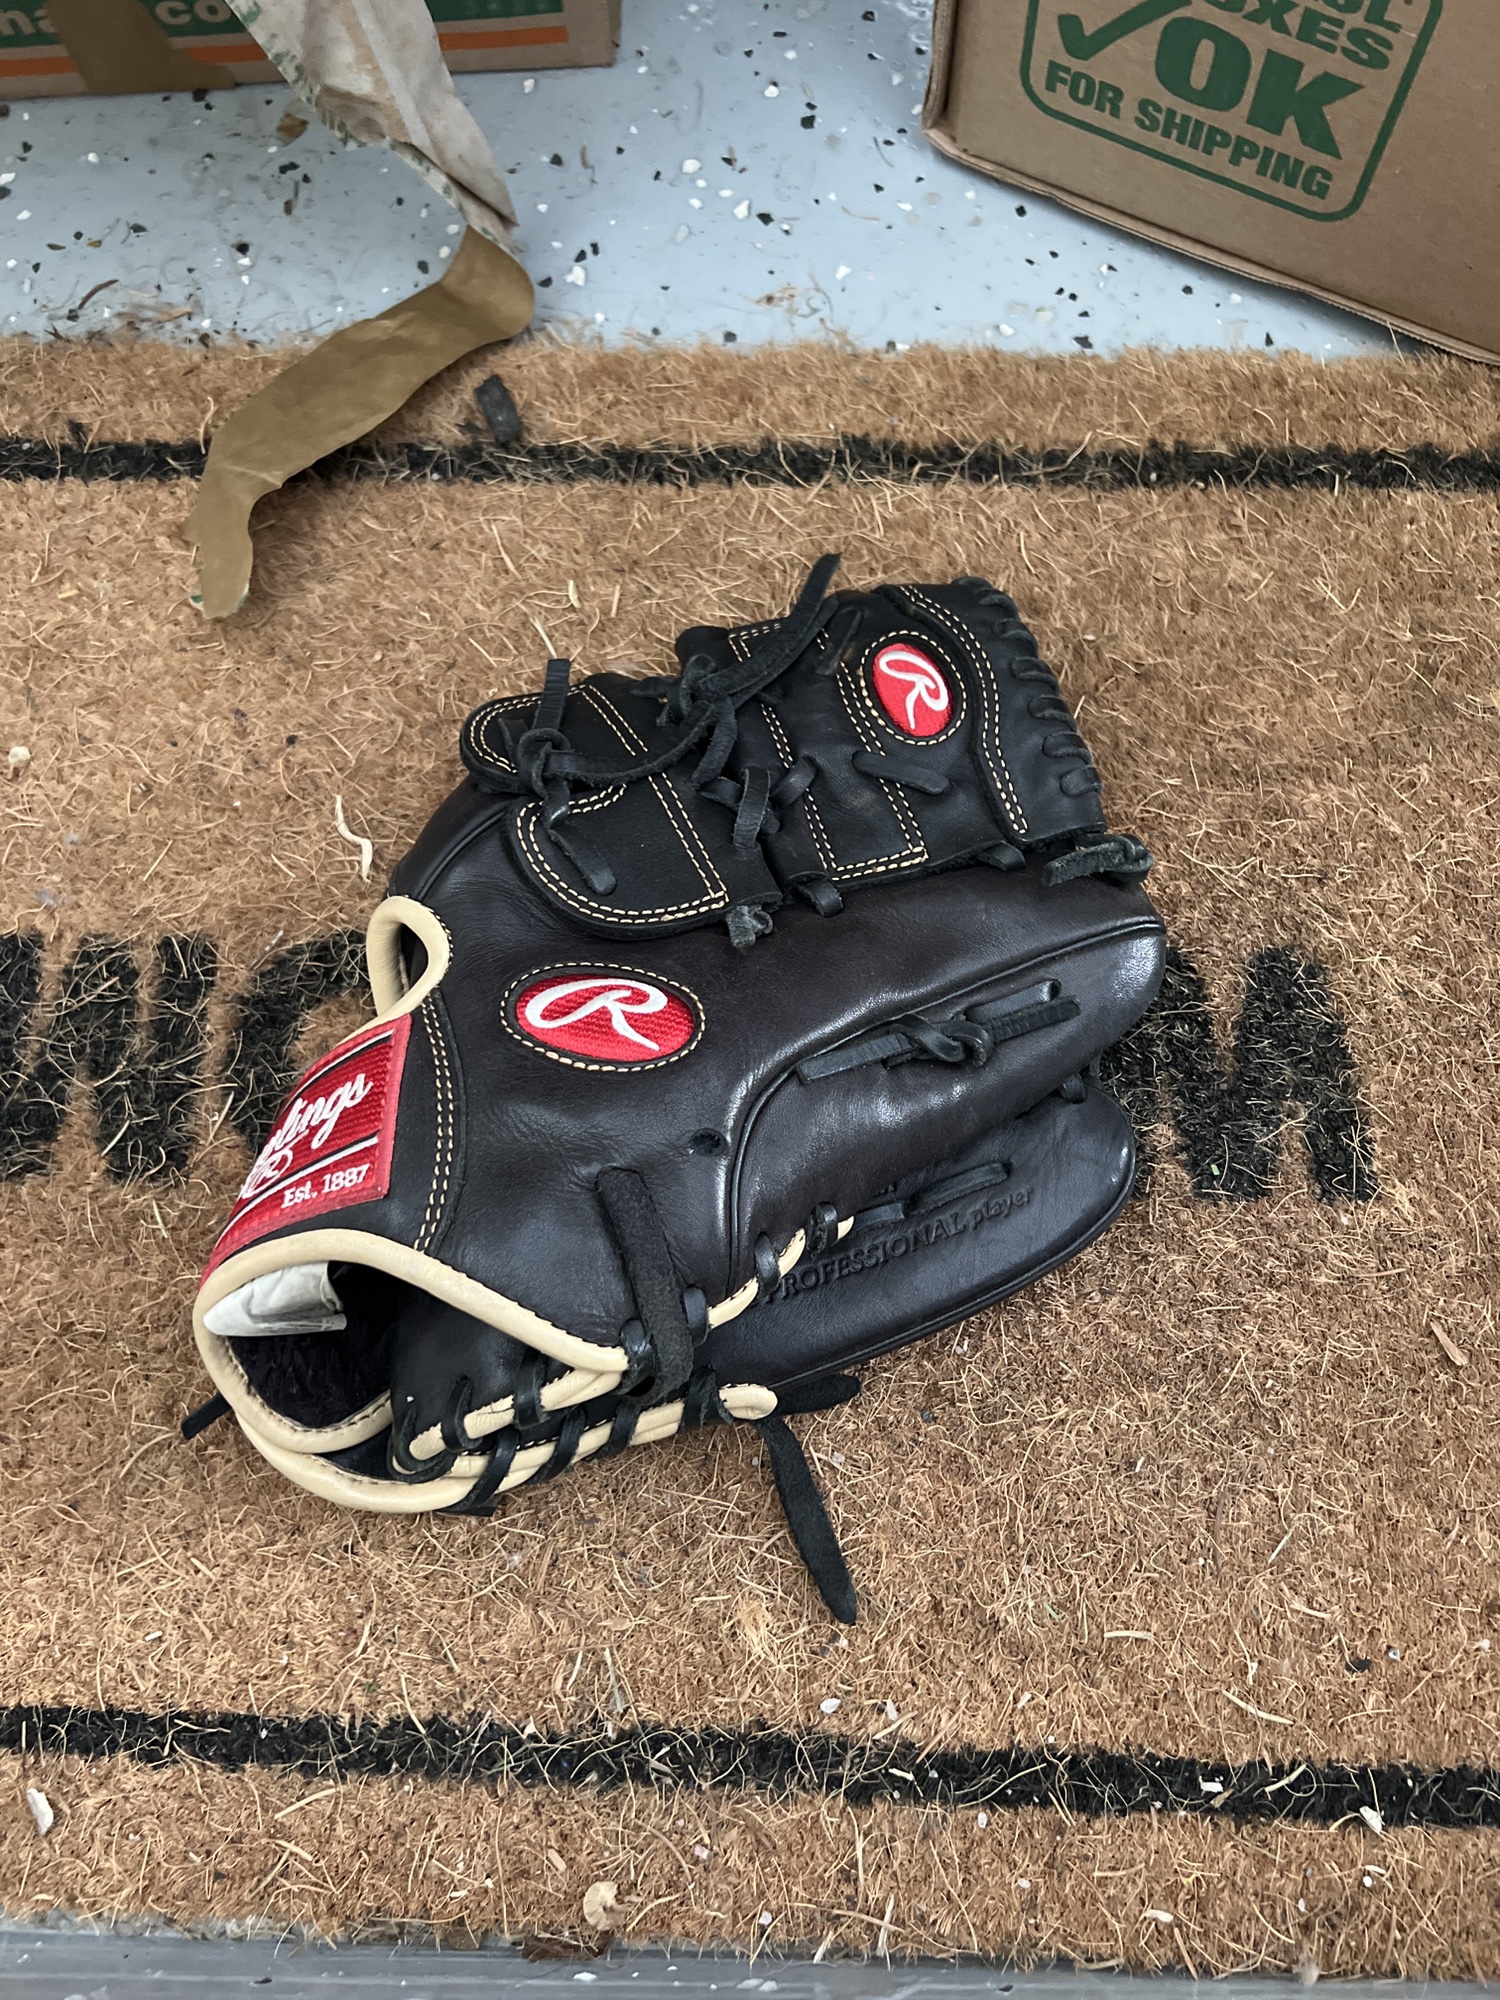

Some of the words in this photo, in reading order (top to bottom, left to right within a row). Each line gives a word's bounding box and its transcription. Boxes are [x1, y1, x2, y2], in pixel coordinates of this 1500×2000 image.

[1044, 59, 1126, 120] FOR
[1134, 98, 1335, 200] SHIPPING
[1155, 16, 1365, 160] OK
[281, 1180, 318, 1209] Est.
[321, 1163, 371, 1194] 1887
[764, 1211, 967, 1305] ROFESSIONAL
[971, 1186, 1034, 1231] player
